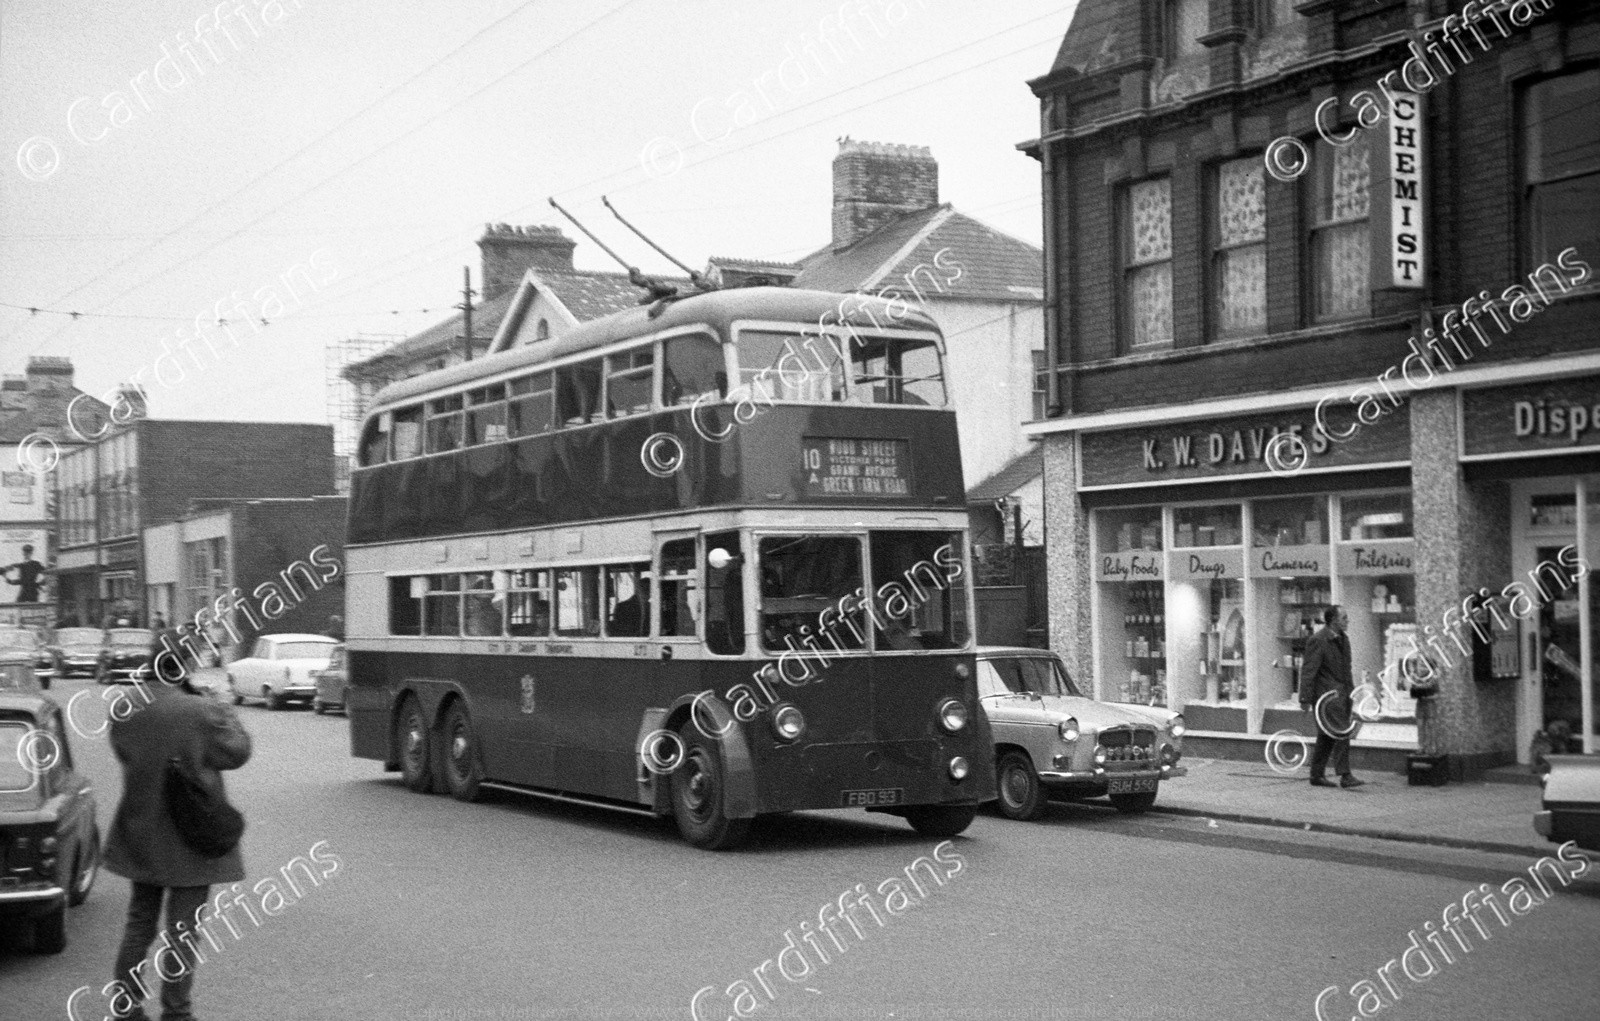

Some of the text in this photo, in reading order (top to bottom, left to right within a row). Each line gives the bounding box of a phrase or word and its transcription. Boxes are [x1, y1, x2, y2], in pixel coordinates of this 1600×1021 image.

[1394, 98, 1418, 280] CHEMIST
[1143, 425, 1328, 469] K. W. DAVIES
[803, 448, 820, 470] 10
[829, 455, 871, 464] VICTORIA
[1103, 554, 1160, 579] Baby Foods
[1189, 555, 1226, 576] Drugs
[1262, 551, 1319, 572] Cameras
